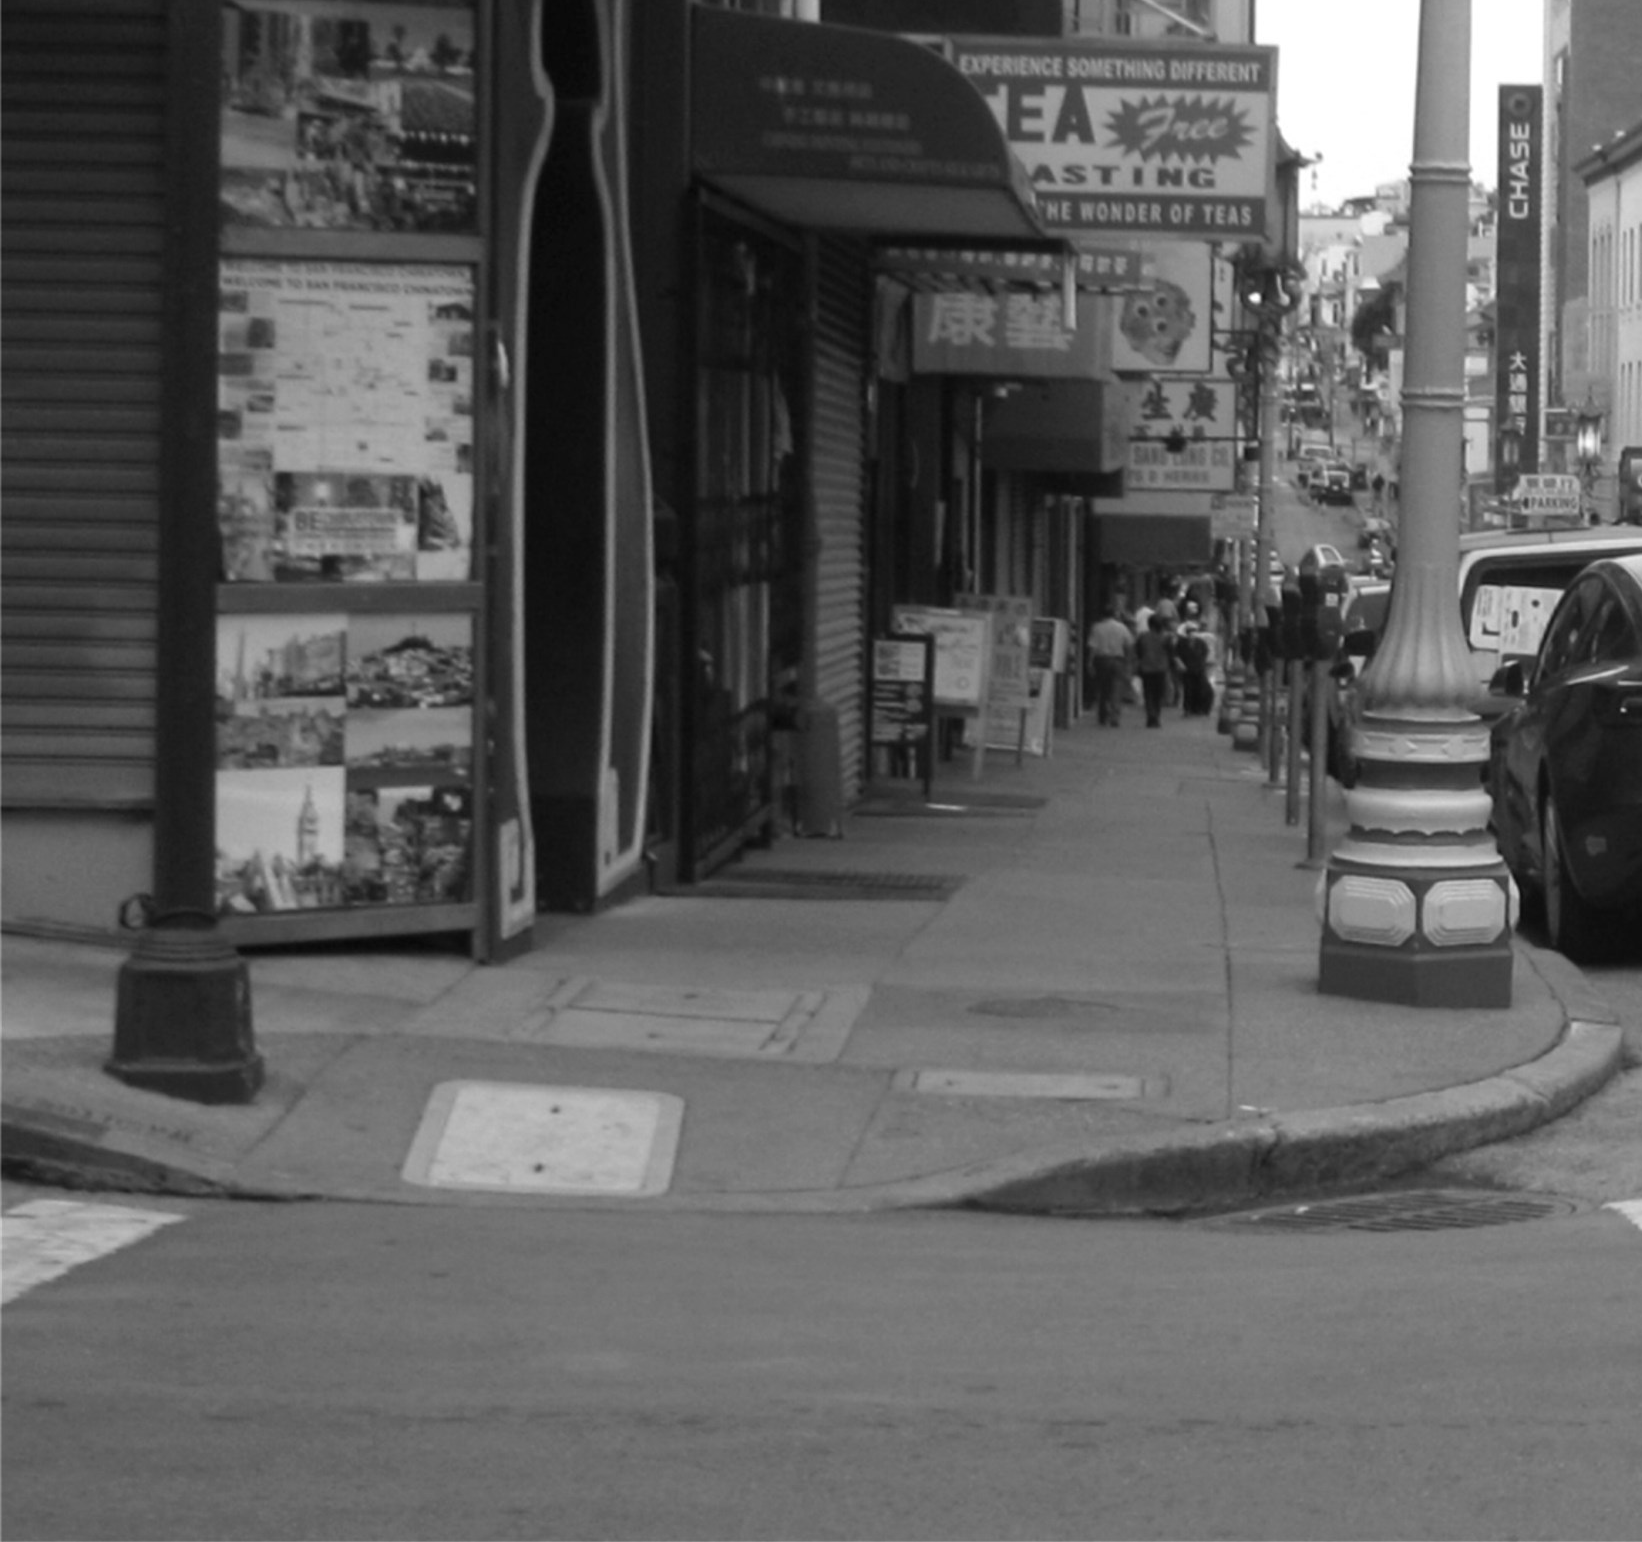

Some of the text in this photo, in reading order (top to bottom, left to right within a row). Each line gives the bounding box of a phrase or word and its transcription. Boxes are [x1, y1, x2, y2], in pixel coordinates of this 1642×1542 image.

[959, 53, 1261, 86] EXPERIENCE SOMETHING DIFFERENT
[990, 81, 1096, 143] EA
[1134, 106, 1230, 152] Free
[1030, 163, 1217, 189] ASTING
[1508, 122, 1531, 220] CHASE
[1080, 202, 1163, 224] WONDER
[1169, 204, 1196, 225] OF
[1202, 205, 1253, 227] TEAS
[1530, 497, 1580, 515] PARKING
